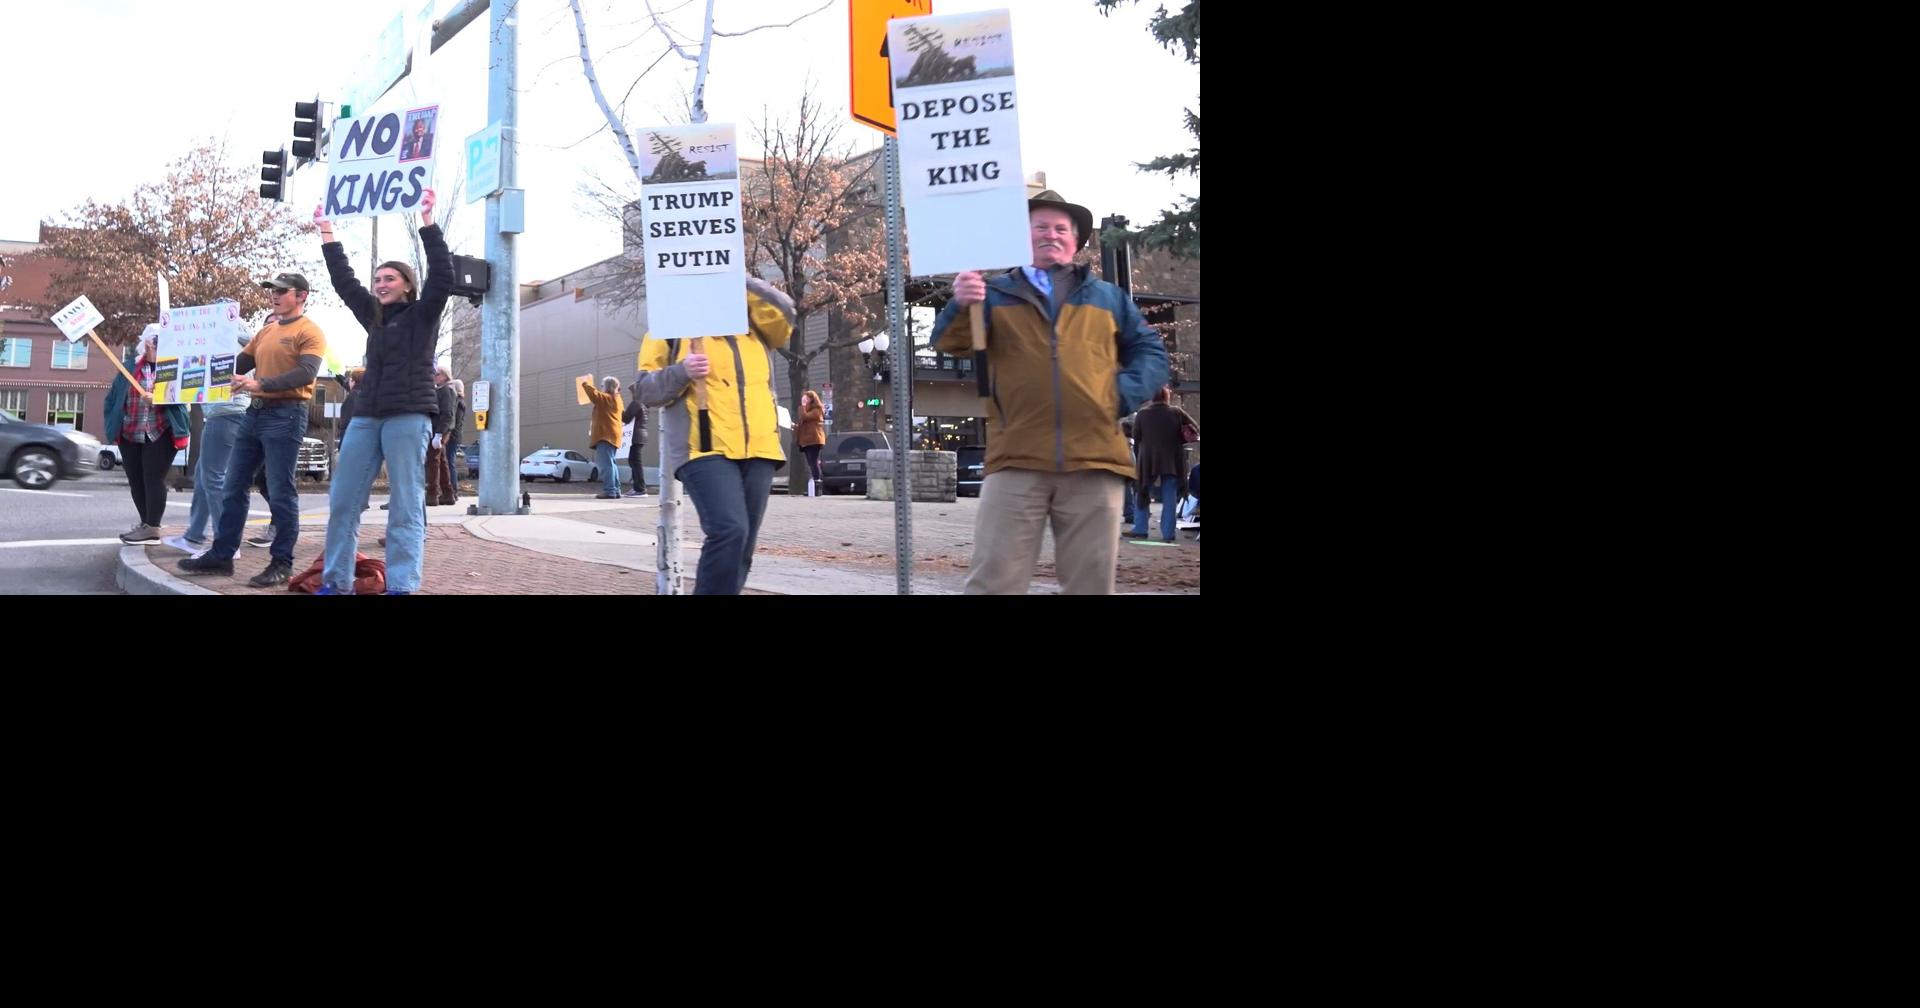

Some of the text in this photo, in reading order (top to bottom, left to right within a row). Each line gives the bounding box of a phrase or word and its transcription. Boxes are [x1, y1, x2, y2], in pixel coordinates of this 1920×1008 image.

[902, 92, 1014, 120] DEPOSE
[340, 112, 400, 159] NO
[931, 127, 990, 150] THE
[689, 143, 729, 154] RESIST
[928, 161, 1000, 186] KING
[325, 166, 426, 216] KINGS
[648, 191, 734, 210] TRUMP
[650, 218, 736, 238] SERVES
[658, 250, 730, 268] PUTIN
